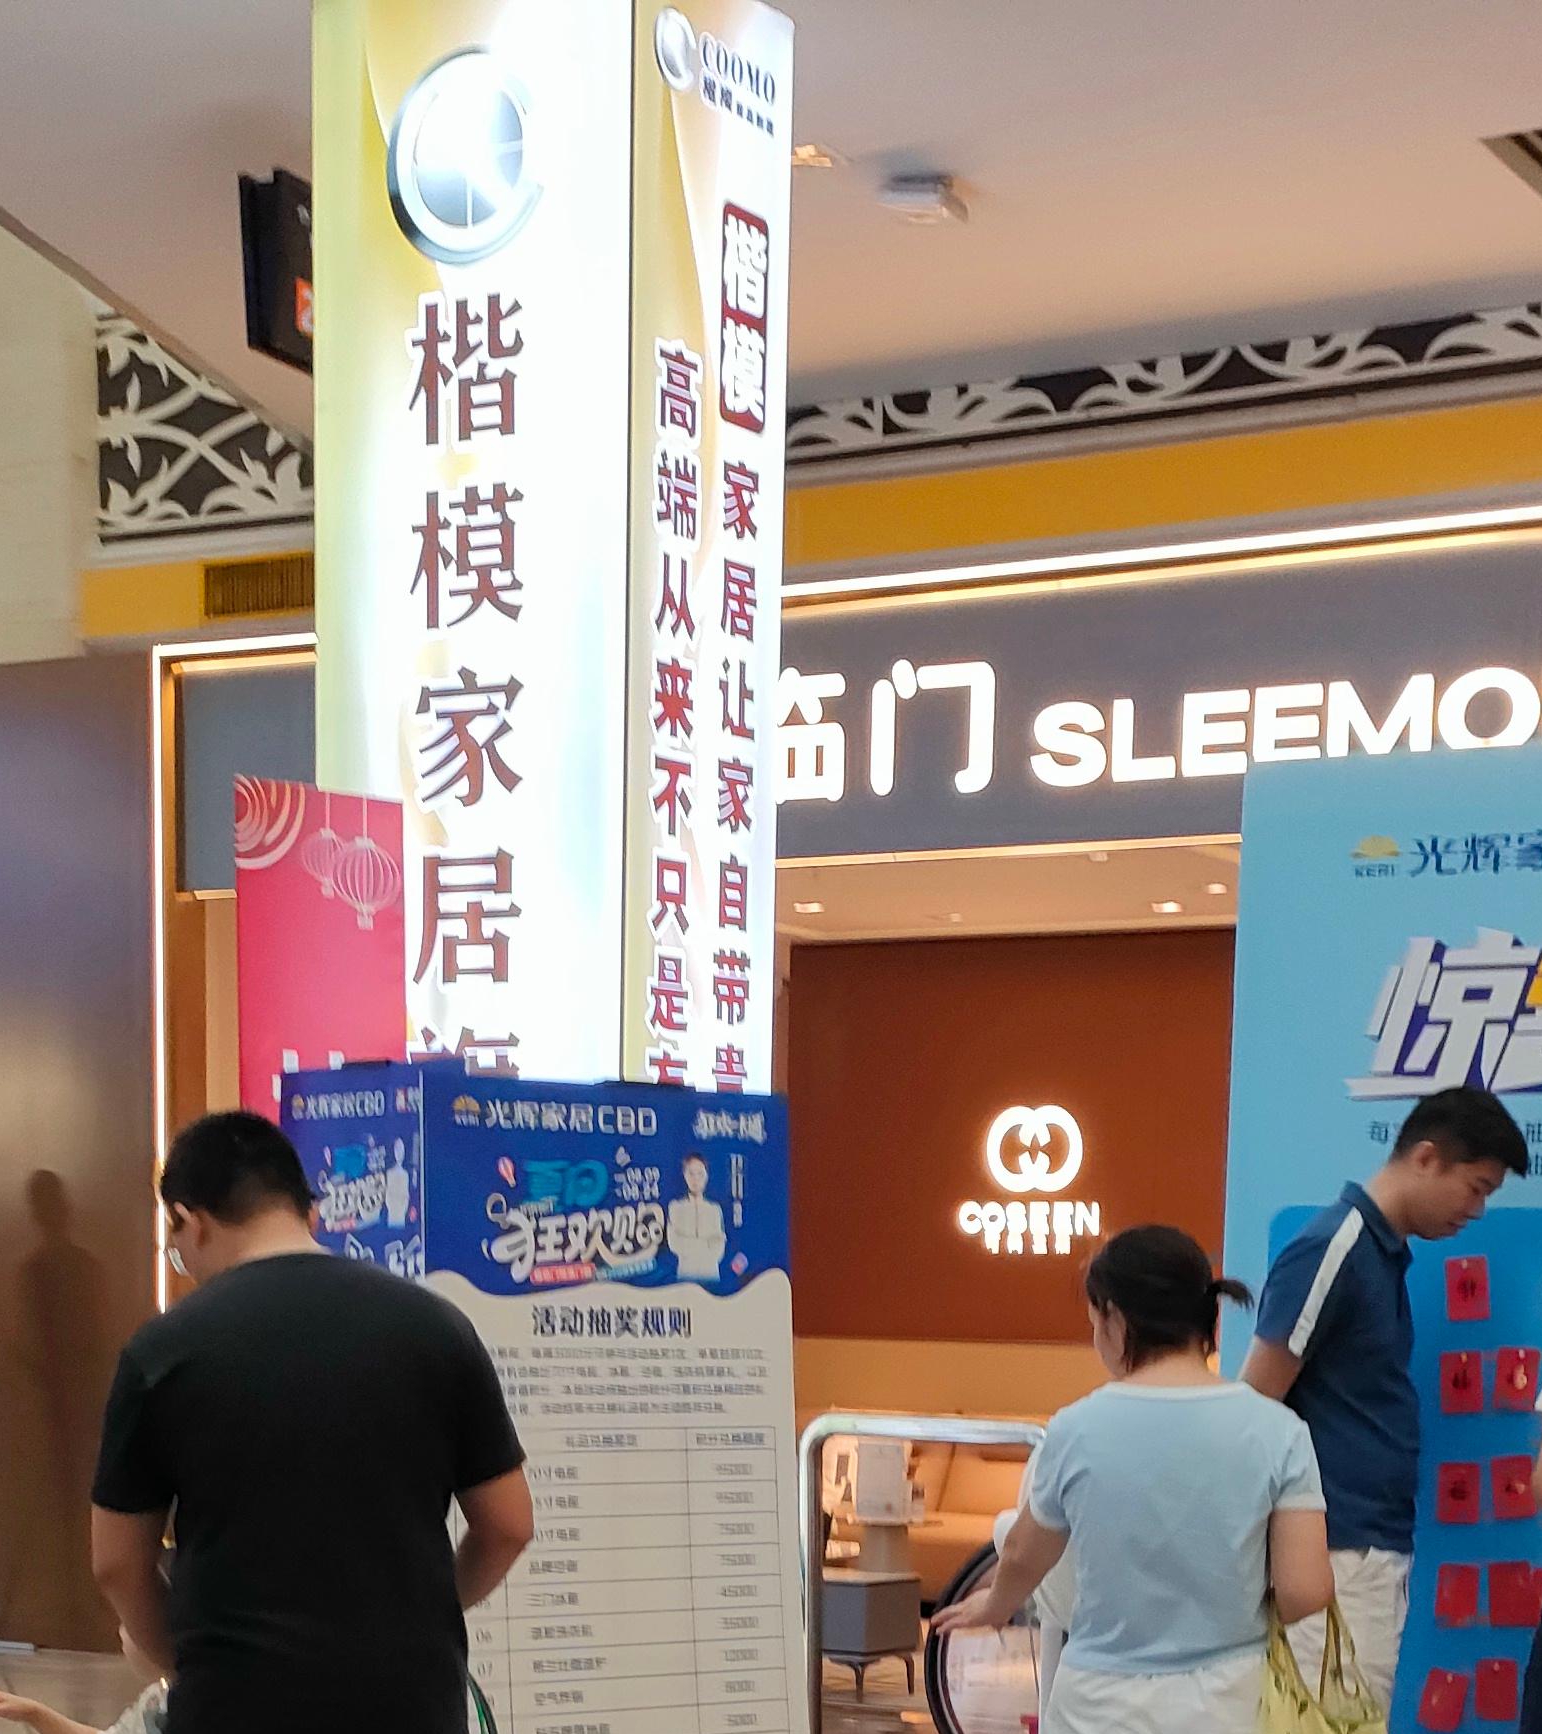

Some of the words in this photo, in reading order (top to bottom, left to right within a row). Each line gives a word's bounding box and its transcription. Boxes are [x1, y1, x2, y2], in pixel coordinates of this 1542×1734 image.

[485, 1098, 658, 1137] 光辉家居CBD
[532, 1304, 692, 1339] 活动抽奖规则
